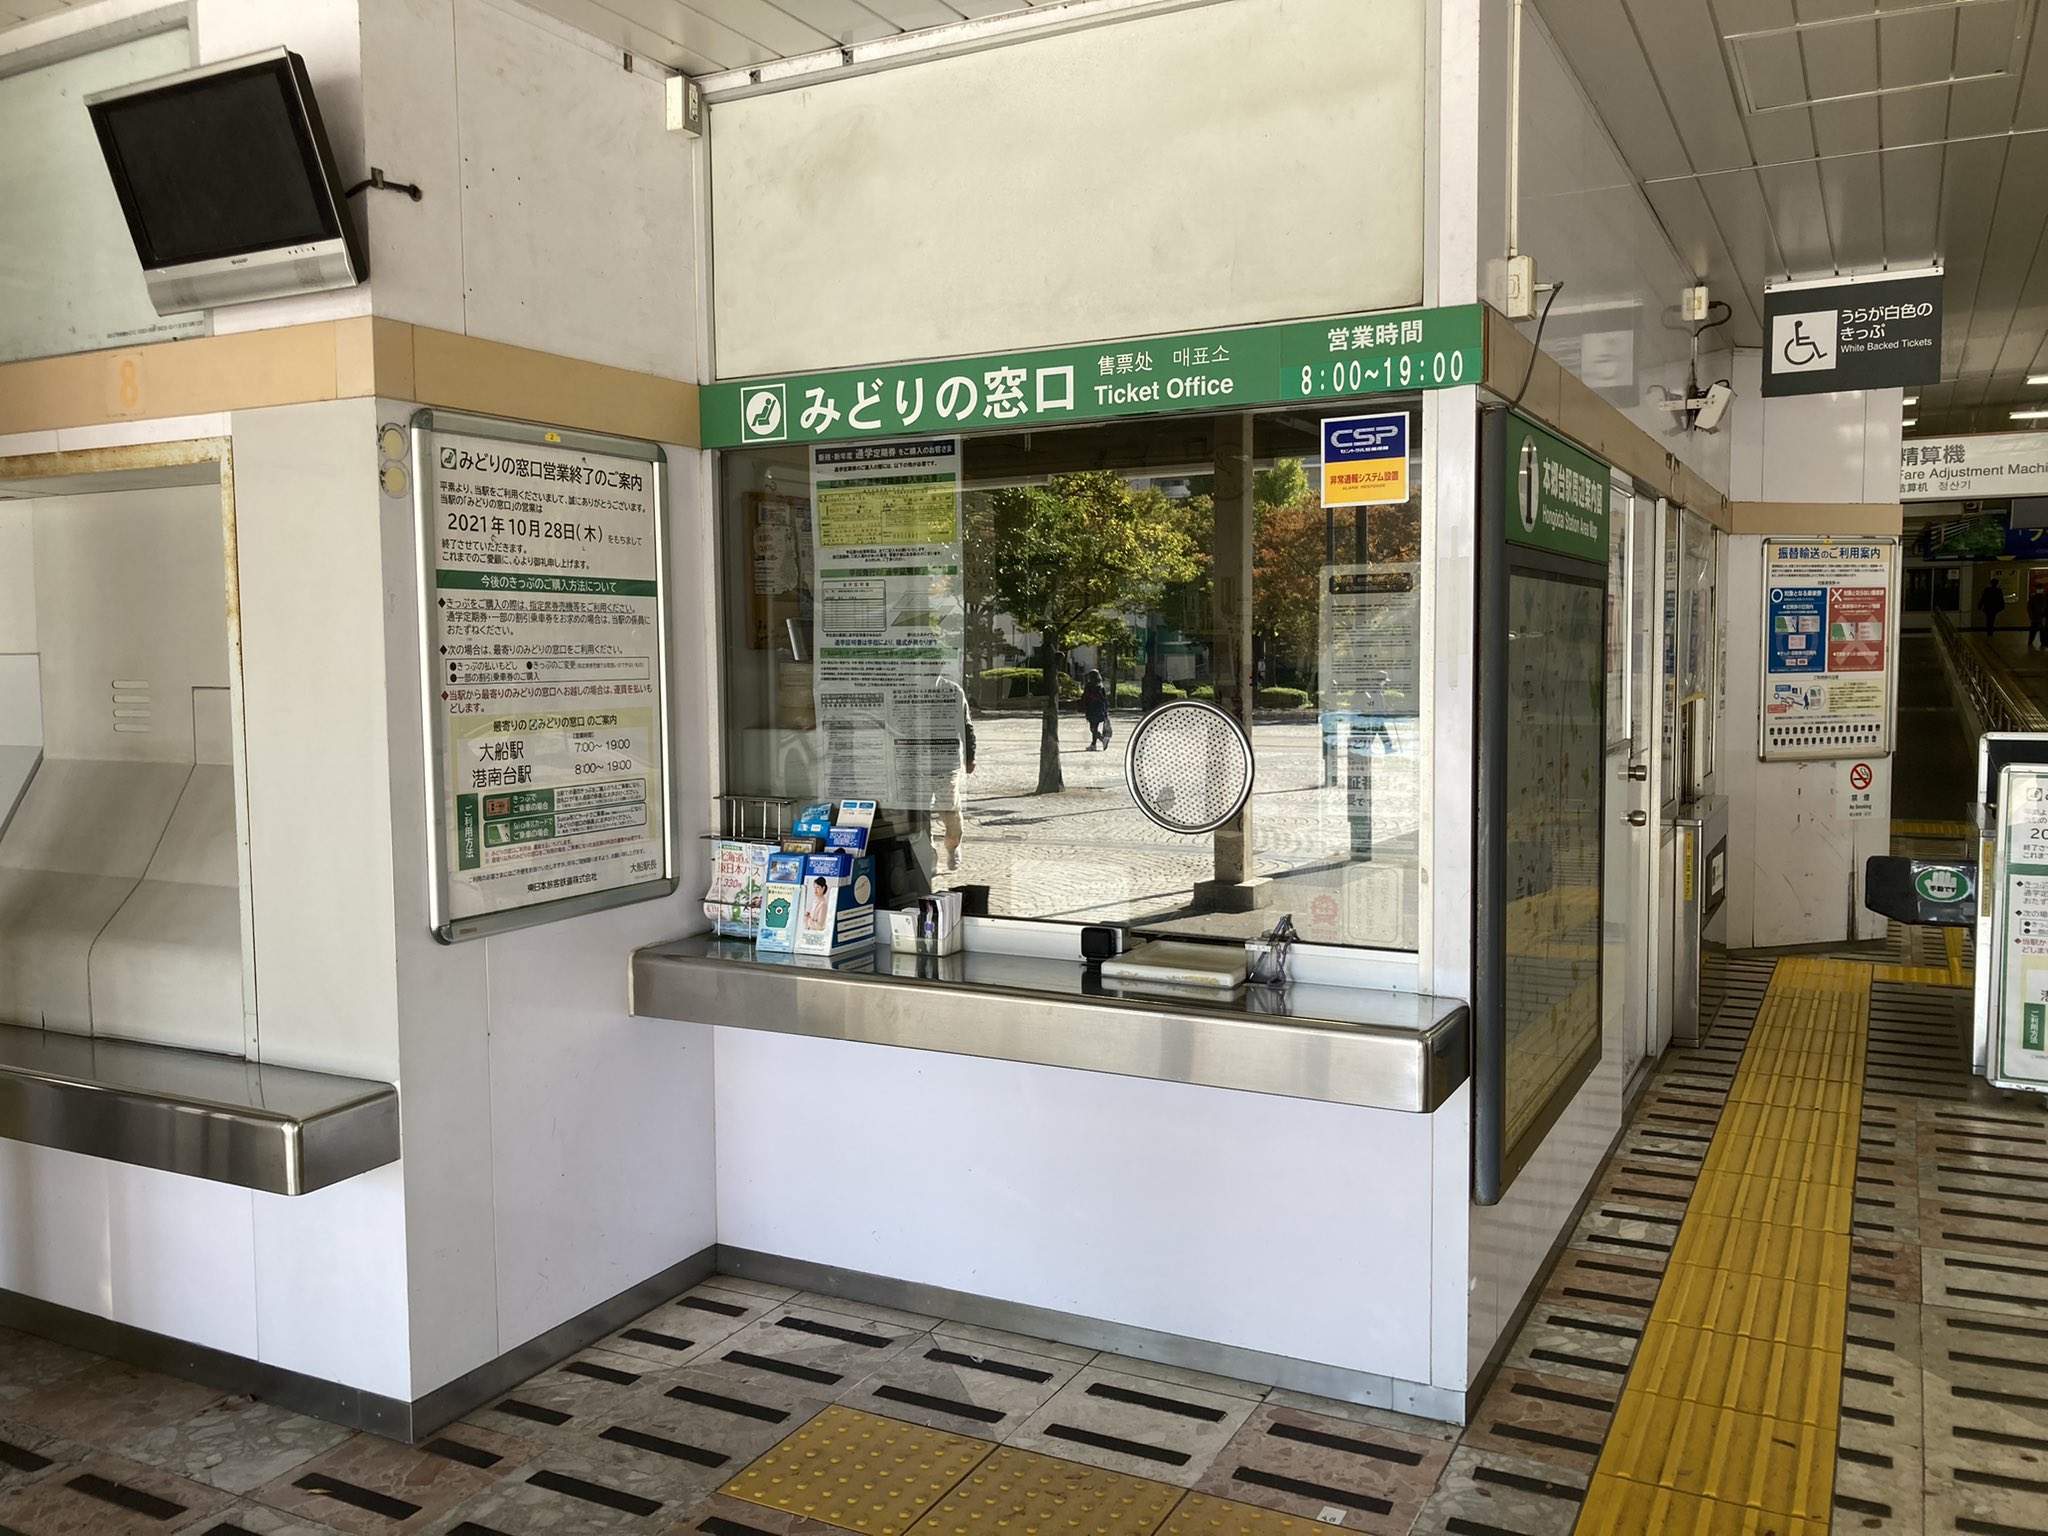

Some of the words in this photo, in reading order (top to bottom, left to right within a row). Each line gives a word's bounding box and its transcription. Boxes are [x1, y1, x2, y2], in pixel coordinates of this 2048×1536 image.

[1841, 302, 1933, 325] うらが白色の
[1328, 319, 1424, 352] 営業時間
[1840, 322, 1886, 341] きっぷ
[1172, 343, 1231, 367] 매표소
[1840, 344, 1865, 353] White
[1867, 340, 1899, 351] Backed
[1901, 338, 1933, 348] Tickets
[1097, 350, 1154, 376] 售票处
[119, 359, 139, 408] 8
[1094, 381, 1160, 406] Ticket
[1166, 374, 1235, 400] Office
[799, 364, 1075, 435] みどりの窓口
[1330, 425, 1399, 448] CSP
[855, 446, 897, 460] 通学定期券
[1900, 443, 1966, 467] 精算機
[459, 450, 643, 492] みどりの窓口営業終了のご案内
[1330, 470, 1399, 485] 非常通報システム設置
[1929, 466, 2005, 481] Adjustment
[1938, 480, 1972, 491] 정산기
[441, 538, 528, 554] 終了させていただきます。
[1777, 546, 1881, 560] 振替輸送のご利用案内
[480, 574, 617, 593] 今後のきっぷのご購入方法について
[446, 624, 514, 636] おたずねください。
[446, 643, 623, 656] 次の場合は、最寄りのみどりの窓口をご利用ください。
[456, 661, 518, 671] きっぷの払いもどし
[456, 672, 540, 683] 一部の割引乗車券のご購入
[449, 702, 485, 714] どします。
[493, 719, 527, 732] 最寄りの
[538, 715, 585, 729] みどりの窓口
[586, 714, 618, 727] のご案内
[479, 740, 525, 763] 大船駅
[471, 764, 533, 789] 港南台駅
